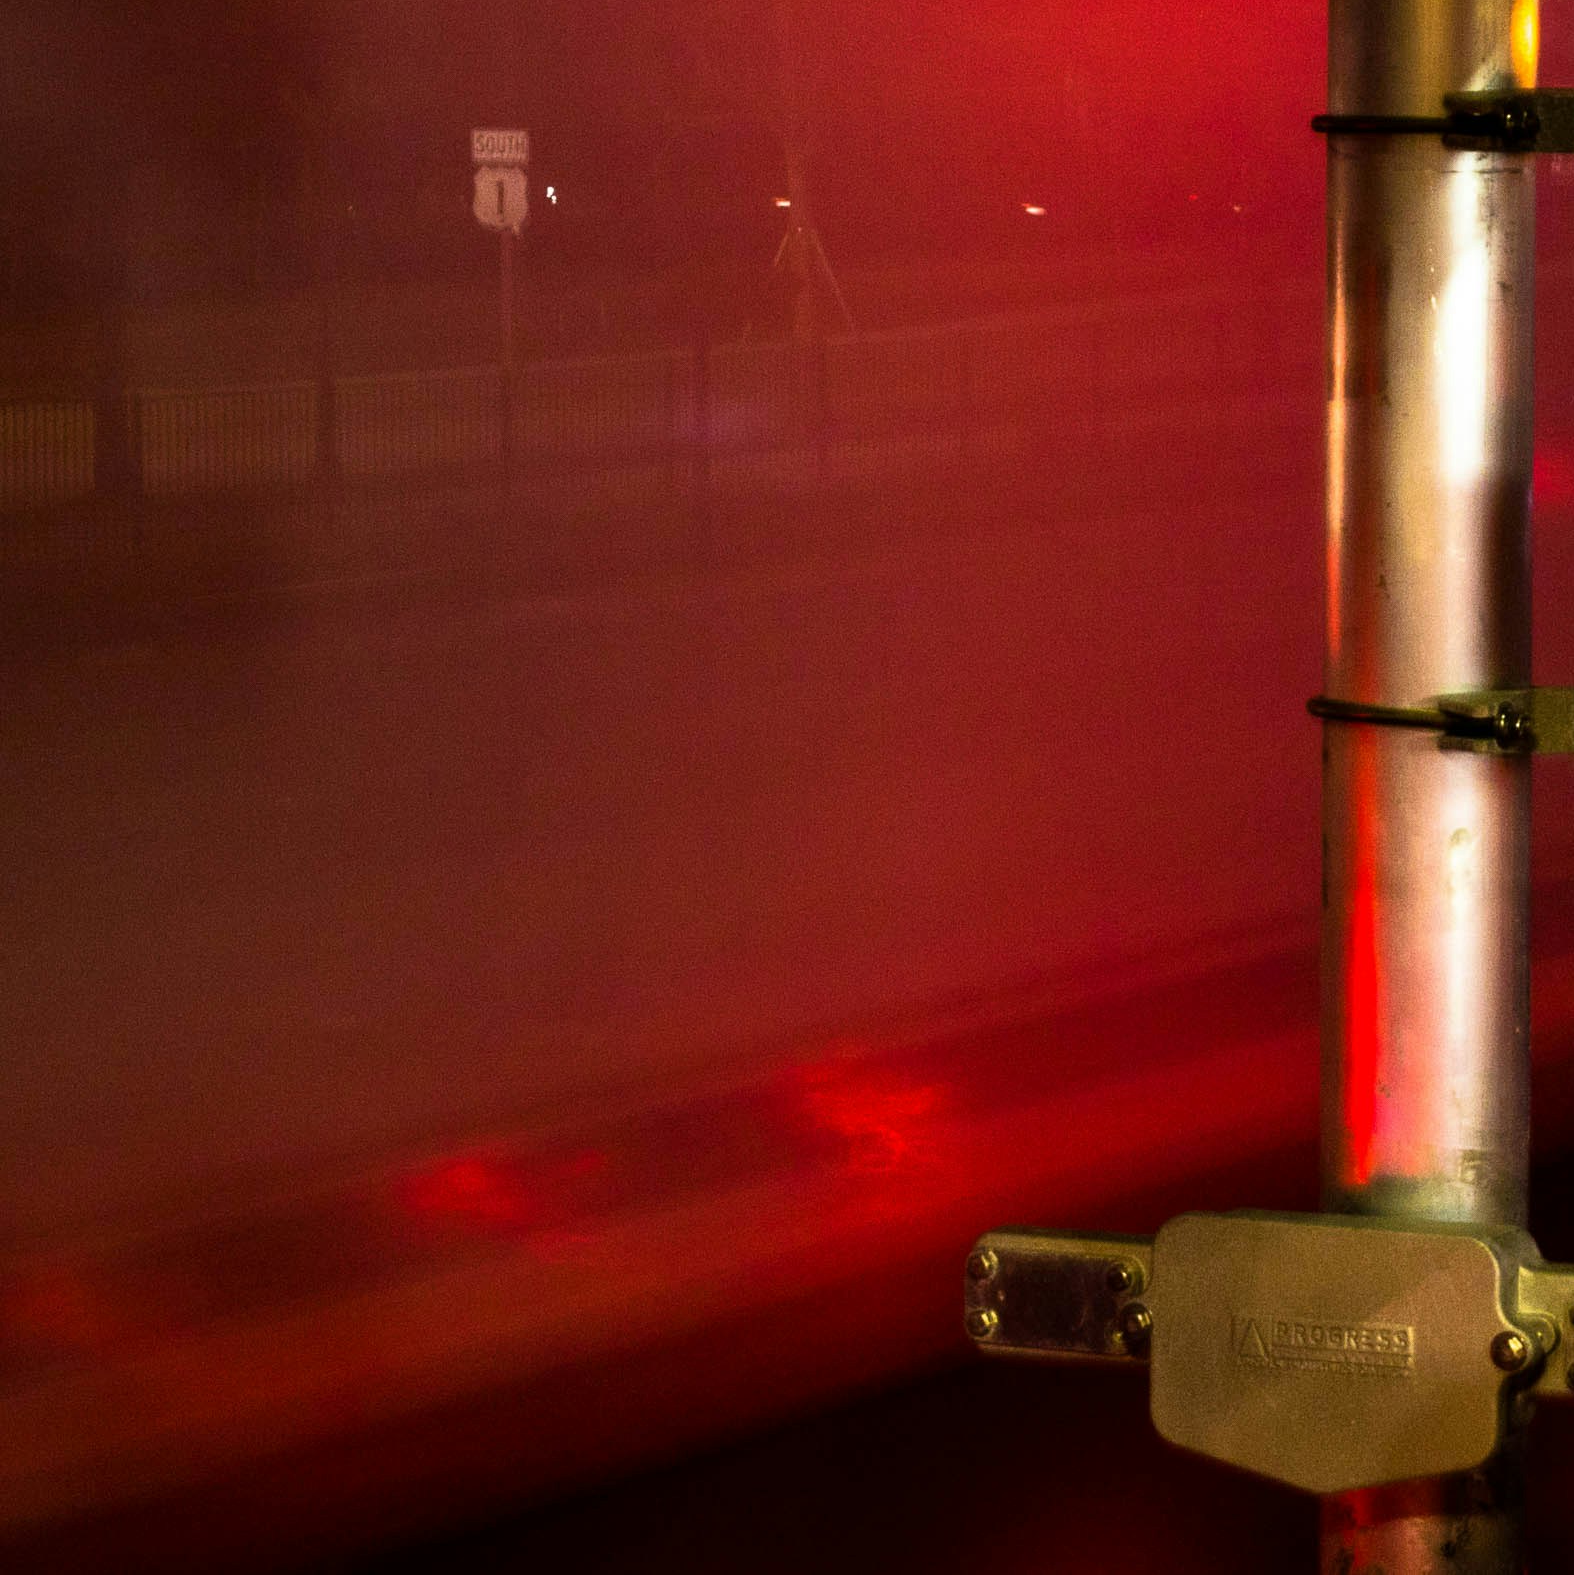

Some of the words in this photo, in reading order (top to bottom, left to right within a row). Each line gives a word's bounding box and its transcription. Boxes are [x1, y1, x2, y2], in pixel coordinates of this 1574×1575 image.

[475, 134, 527, 154] SOUTH
[496, 180, 504, 214] 1
[1275, 1321, 1408, 1350] PROGRESS
